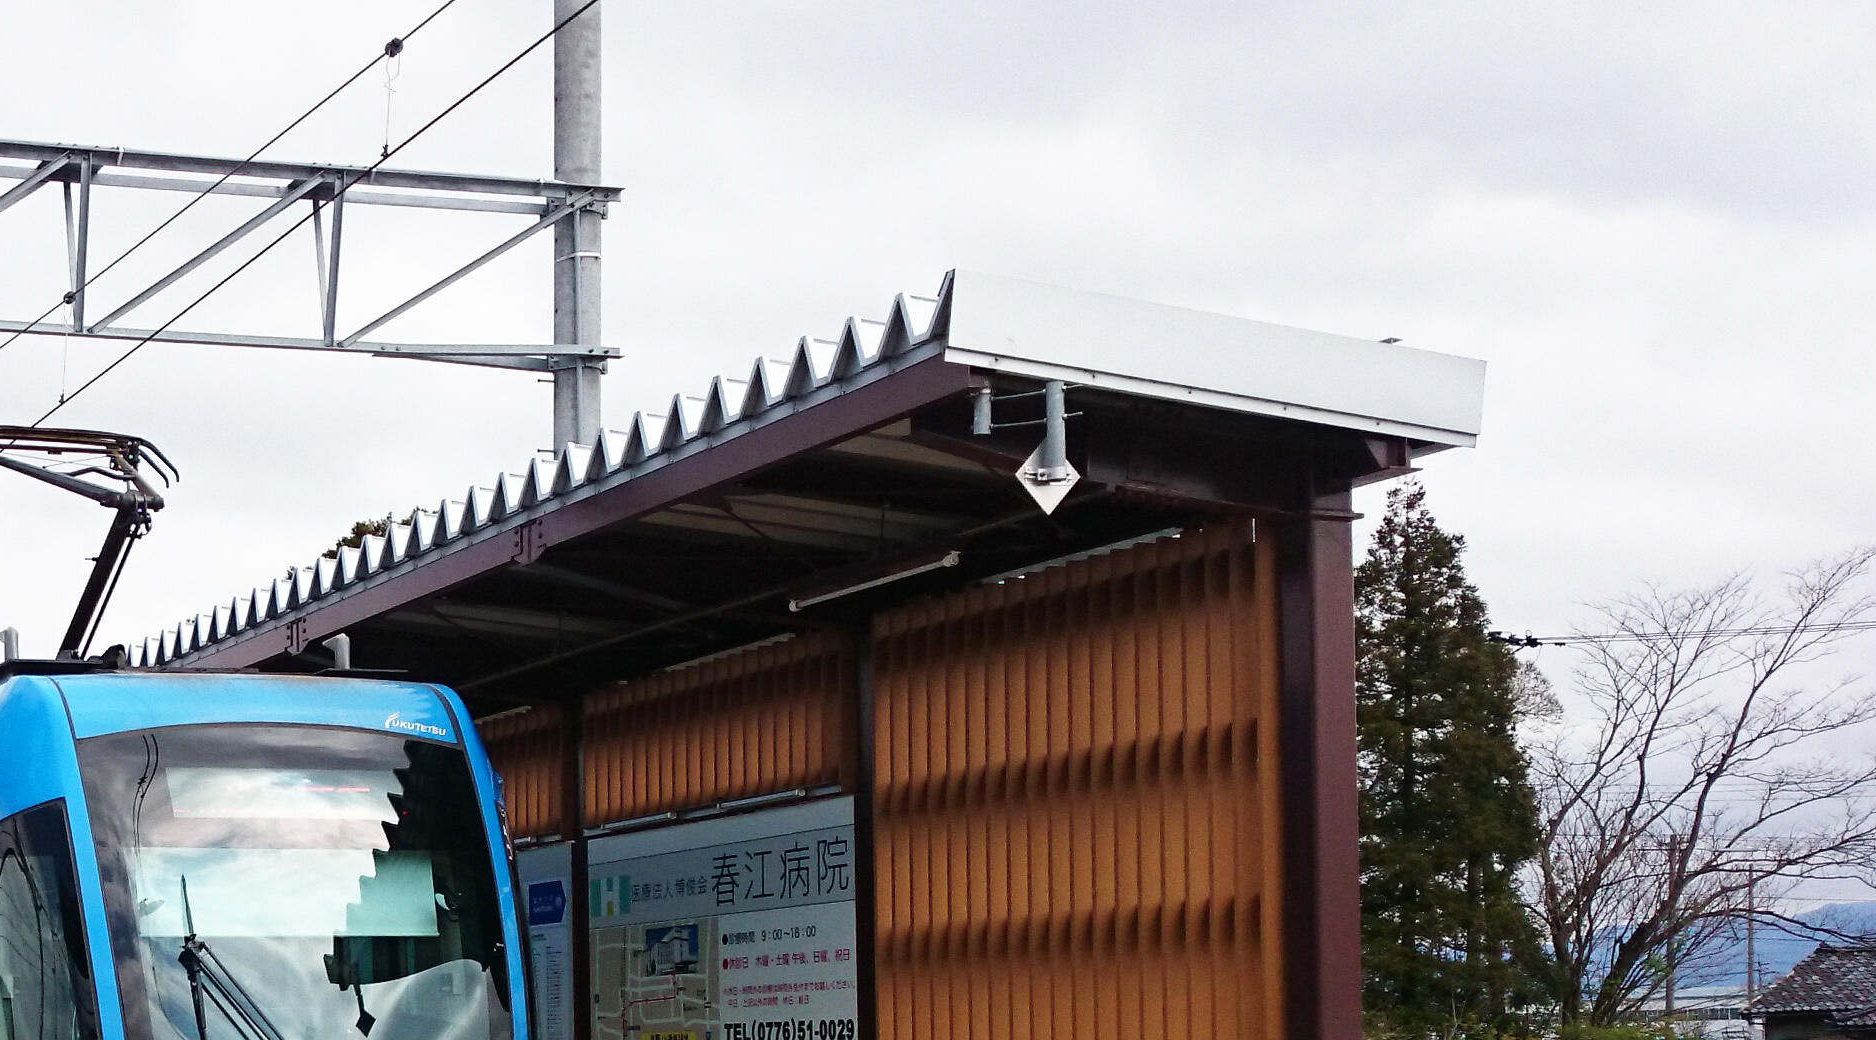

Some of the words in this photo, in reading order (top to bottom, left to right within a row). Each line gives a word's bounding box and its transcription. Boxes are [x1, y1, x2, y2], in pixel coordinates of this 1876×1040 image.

[385, 712, 447, 736] FUKUTETSU
[712, 836, 850, 907] 春江病院
